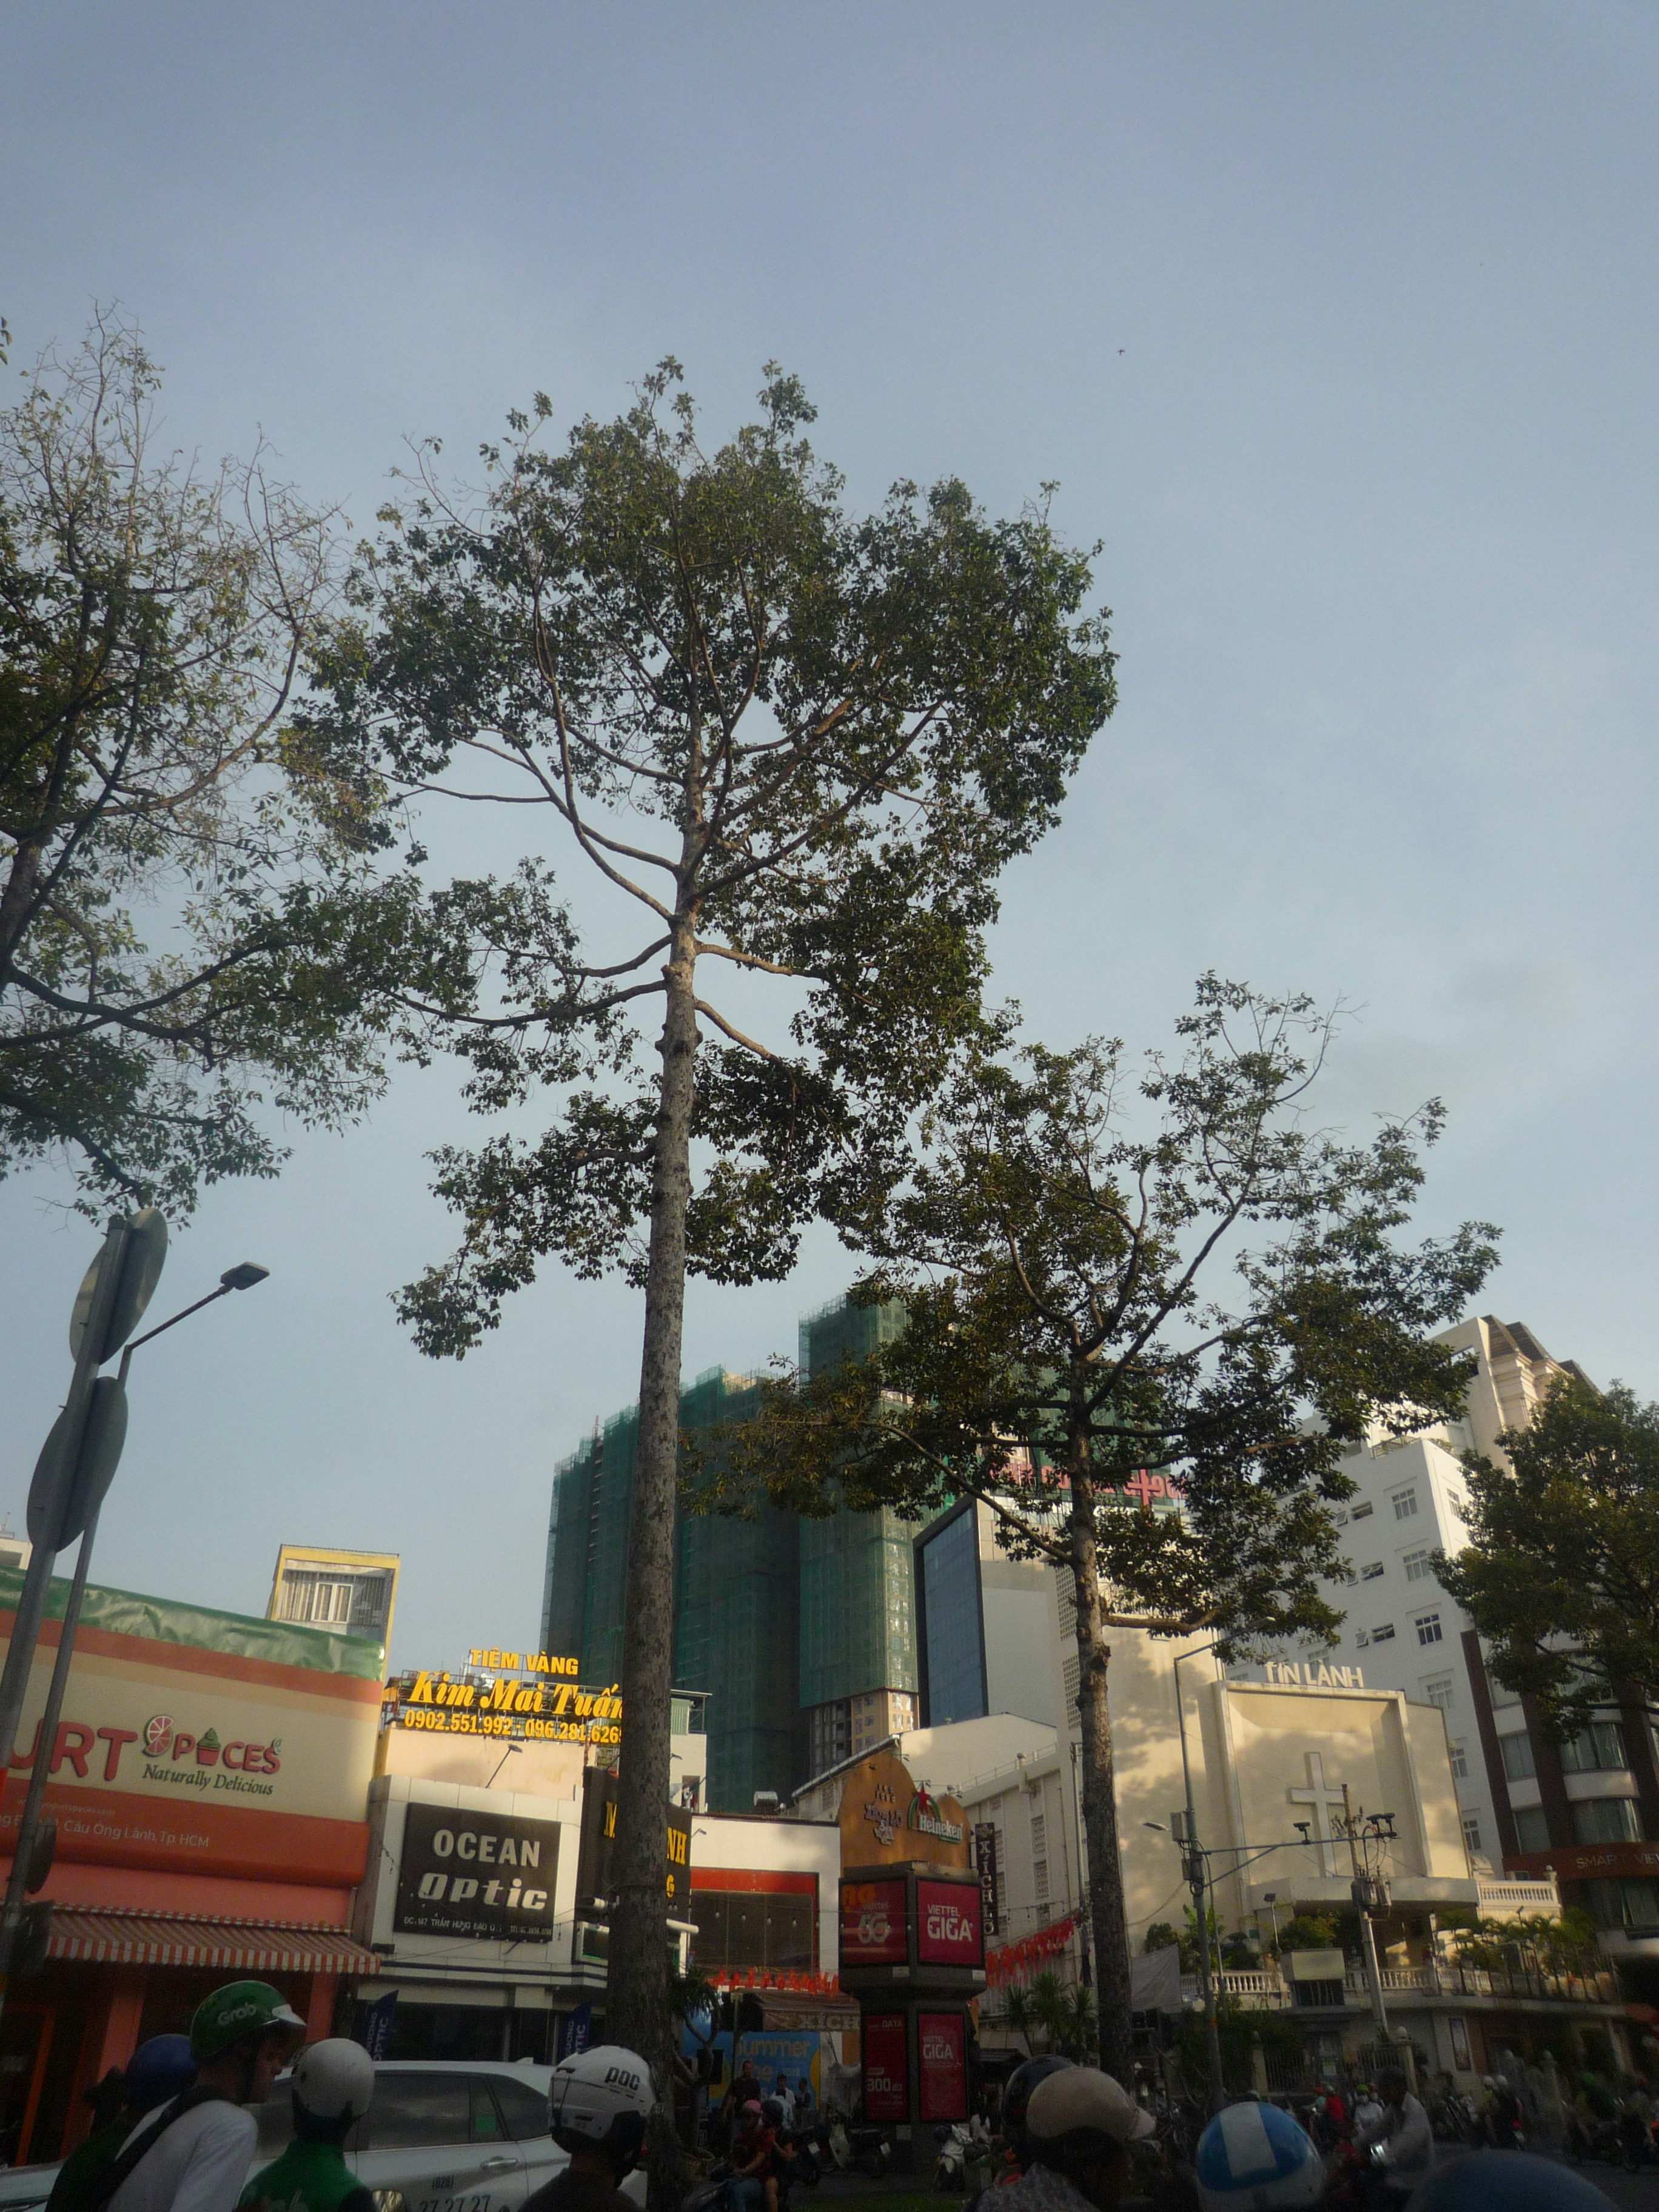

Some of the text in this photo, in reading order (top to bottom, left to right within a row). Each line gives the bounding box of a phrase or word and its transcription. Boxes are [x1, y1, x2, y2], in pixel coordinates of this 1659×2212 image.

[471, 1647, 578, 1676] TIỆM VÀNG
[1304, 1659, 1364, 1689] LÀNH
[407, 1671, 475, 1708] Kim
[480, 1678, 545, 1713] Mai
[404, 1709, 512, 1736] 0902.551.992
[142, 1763, 274, 1795] Naturally Delicious
[919, 1813, 963, 1840] Heineken
[180, 1833, 209, 1848] HCM
[432, 1829, 541, 1868] OCEAN
[417, 1872, 548, 1911] Optic
[927, 1904, 961, 1917] VIETTEL
[927, 1916, 973, 1942] GIGA
[218, 2002, 257, 2026] Grab
[922, 2043, 954, 2060] GIGA
